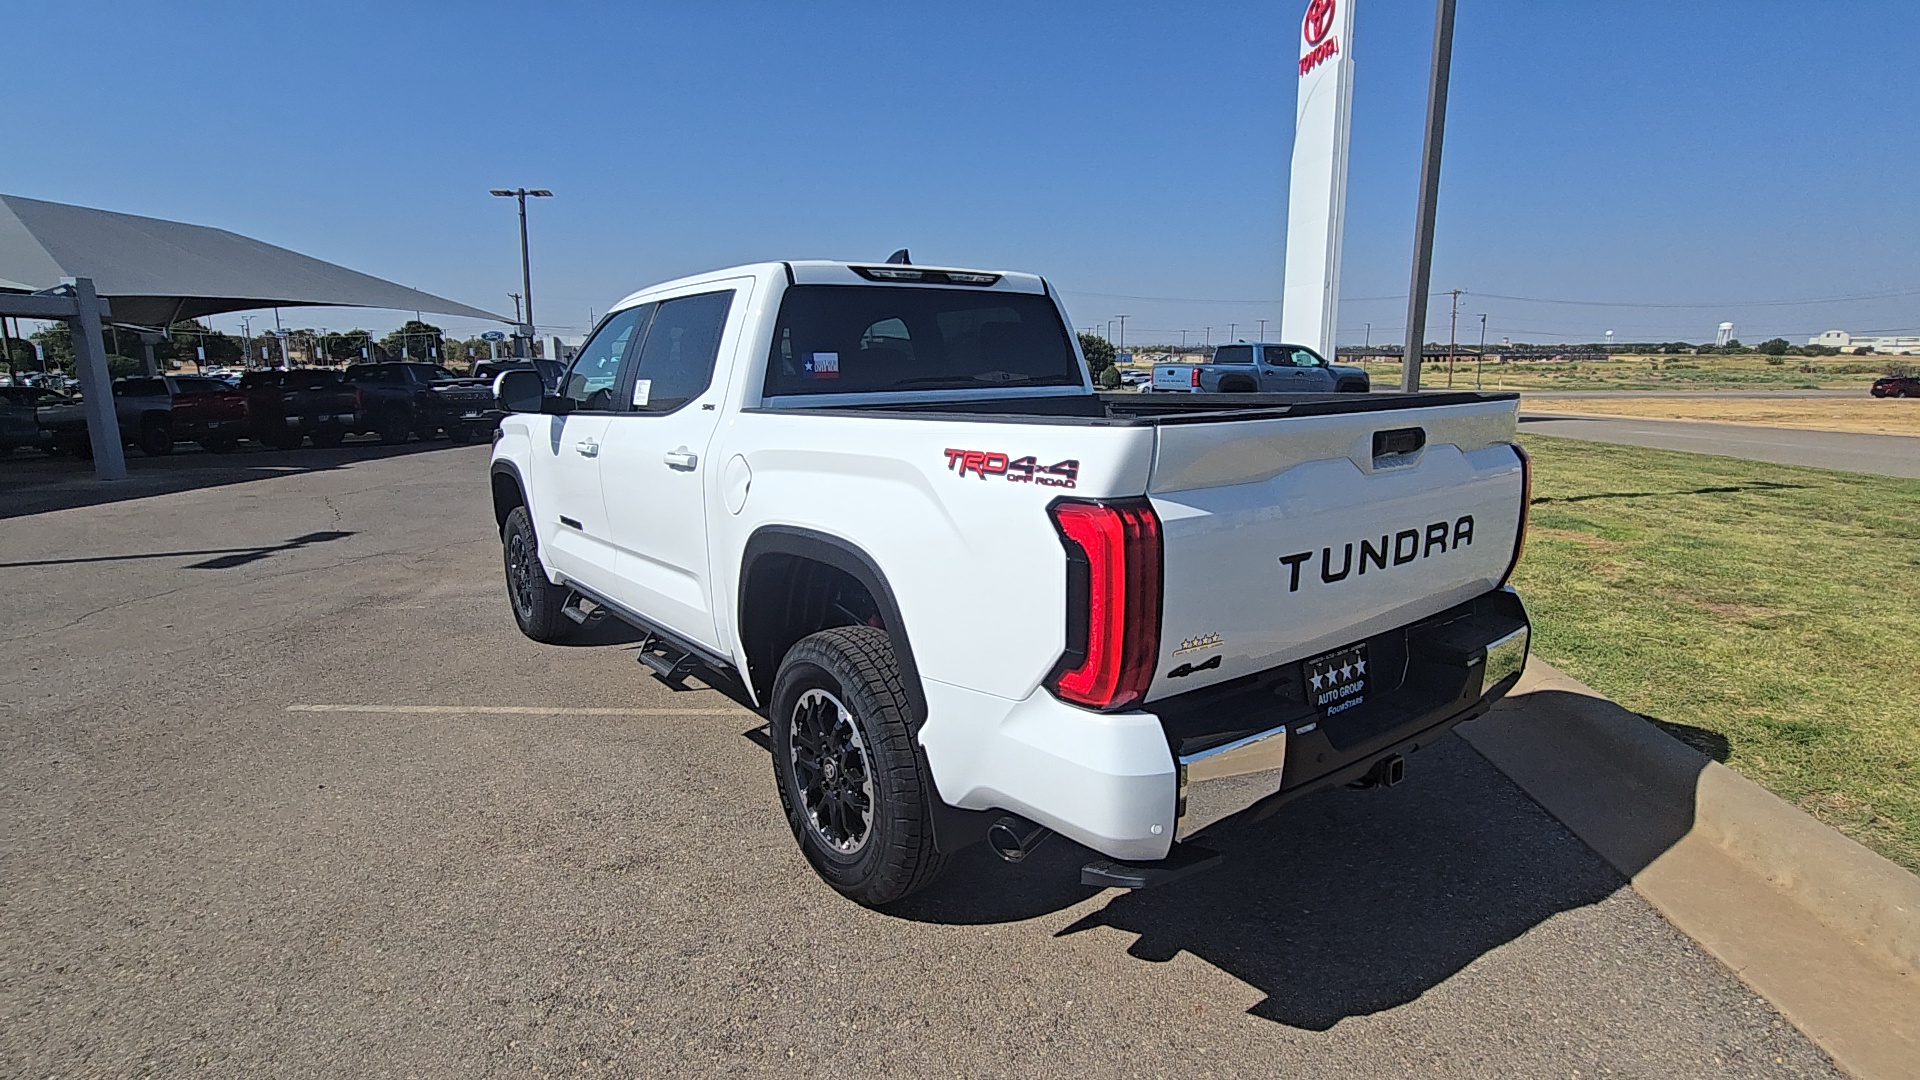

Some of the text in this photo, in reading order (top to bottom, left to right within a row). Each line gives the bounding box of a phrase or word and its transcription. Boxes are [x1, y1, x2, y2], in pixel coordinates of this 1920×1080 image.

[1299, 35, 1339, 78] TOYOTA
[944, 448, 1009, 481] TRD
[1007, 474, 1076, 489] OFF ROAD
[1279, 514, 1475, 593] TUNDRA
[1318, 680, 1365, 706] AUTO GROUP
